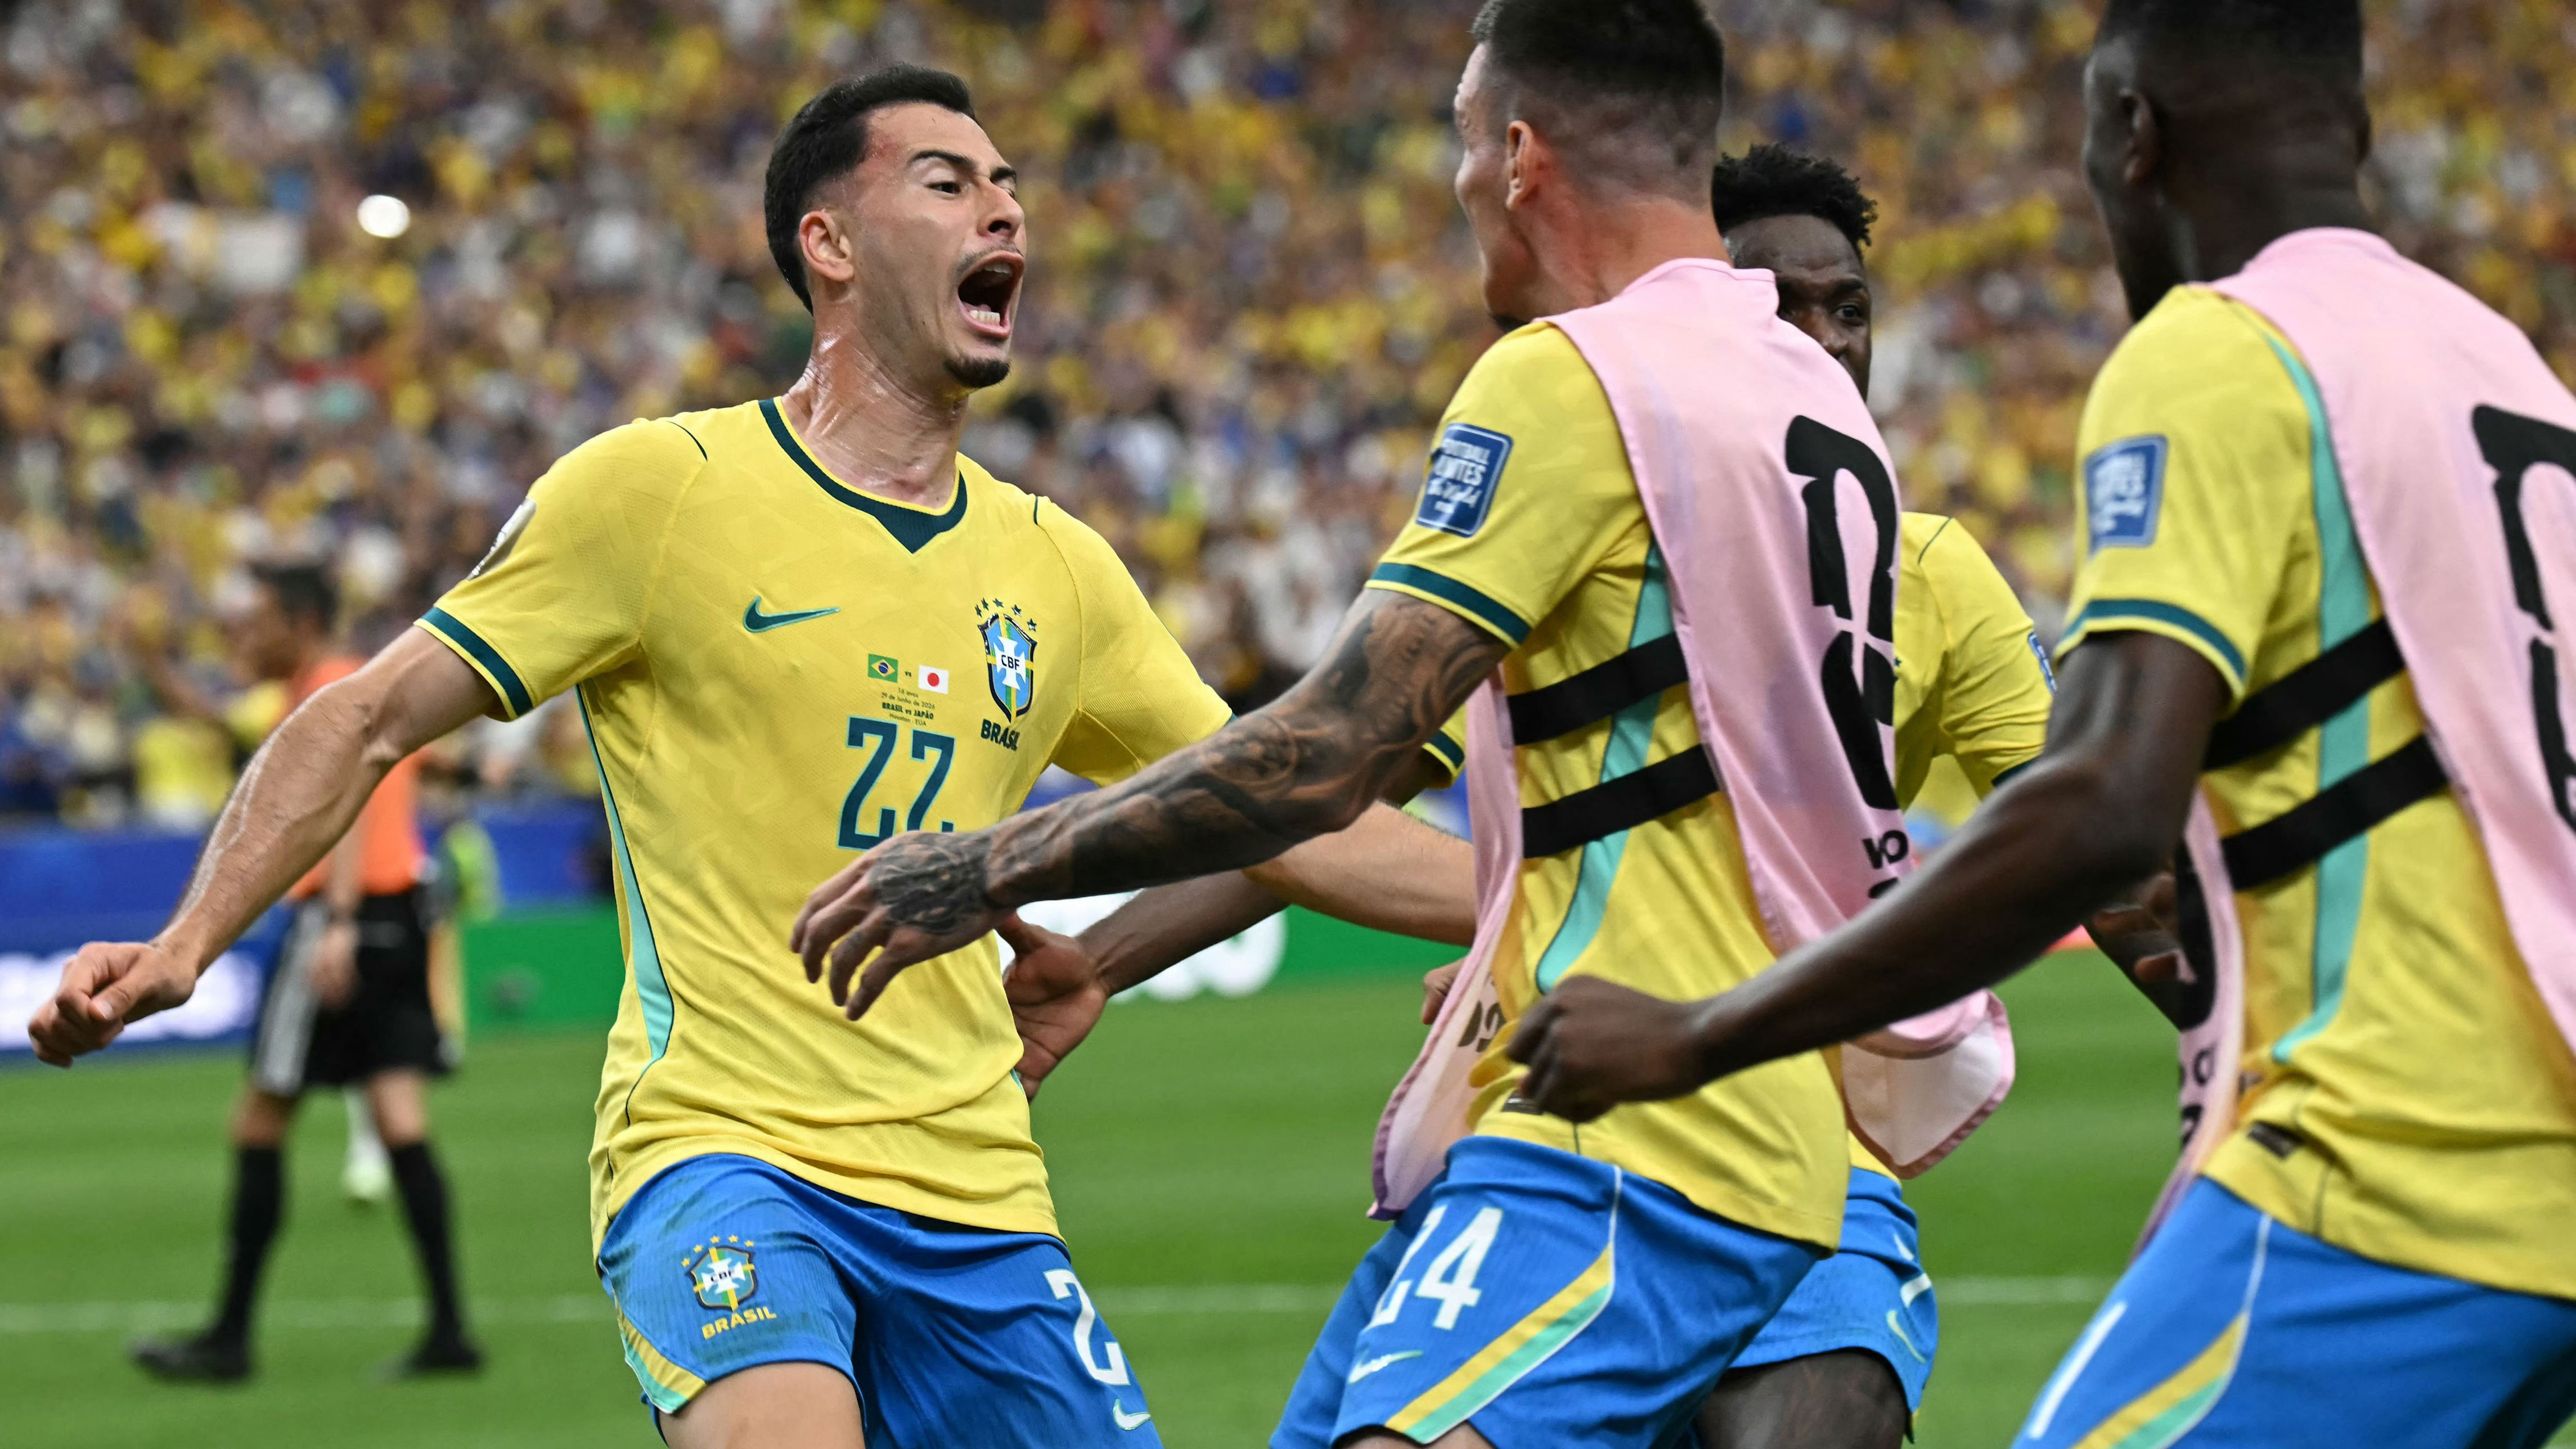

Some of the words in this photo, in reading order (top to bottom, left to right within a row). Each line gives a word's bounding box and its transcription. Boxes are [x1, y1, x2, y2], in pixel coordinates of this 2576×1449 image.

[1001, 654, 1021, 670] CBF
[882, 702, 903, 713] BRASIL
[914, 709, 934, 720] JAPÃO
[981, 718, 1020, 752] BRASIL
[837, 715, 956, 852] 22
[1366, 1204, 1503, 1331] 24
[702, 1306, 777, 1340] BRASIL
